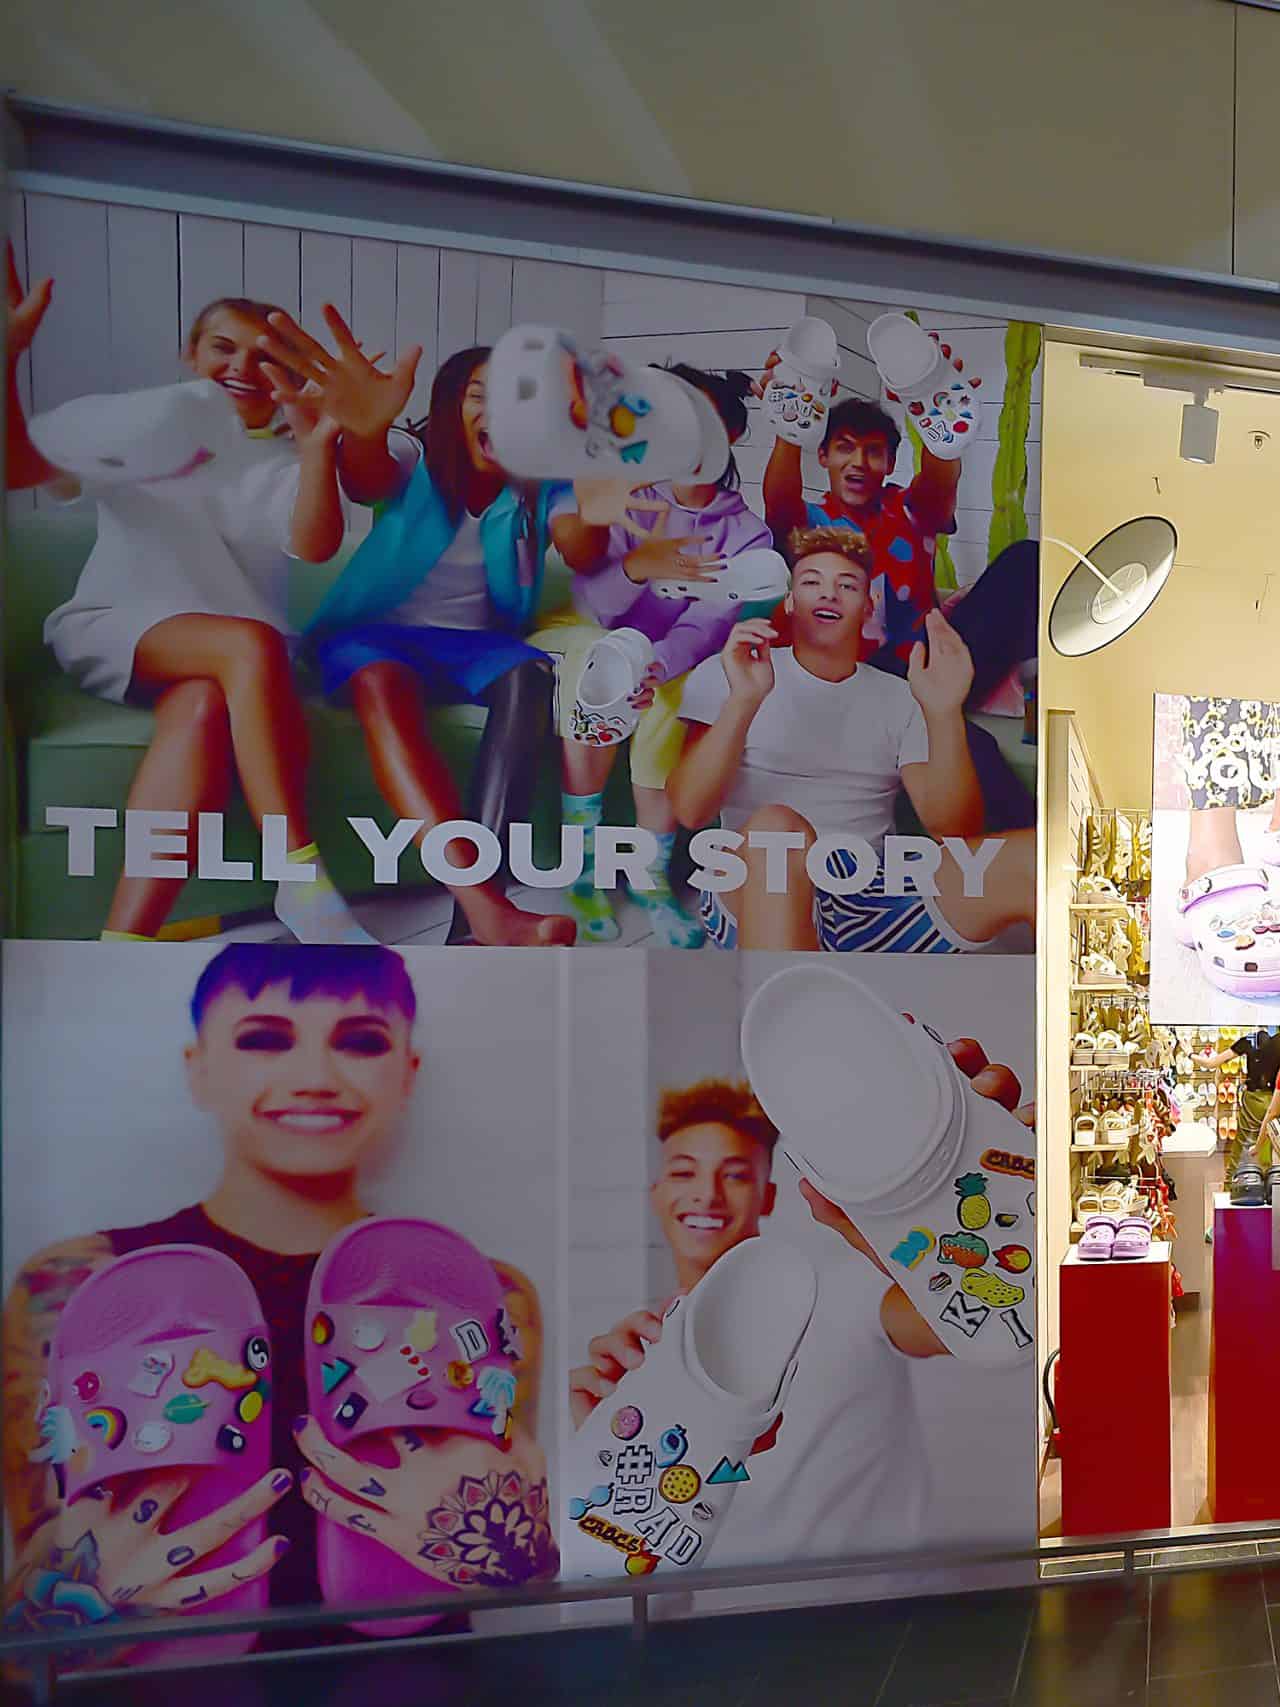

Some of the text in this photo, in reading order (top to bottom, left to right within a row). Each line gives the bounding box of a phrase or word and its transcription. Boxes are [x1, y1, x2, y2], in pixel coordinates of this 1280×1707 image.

[45, 805, 1006, 898] TELL YOUR STORY
